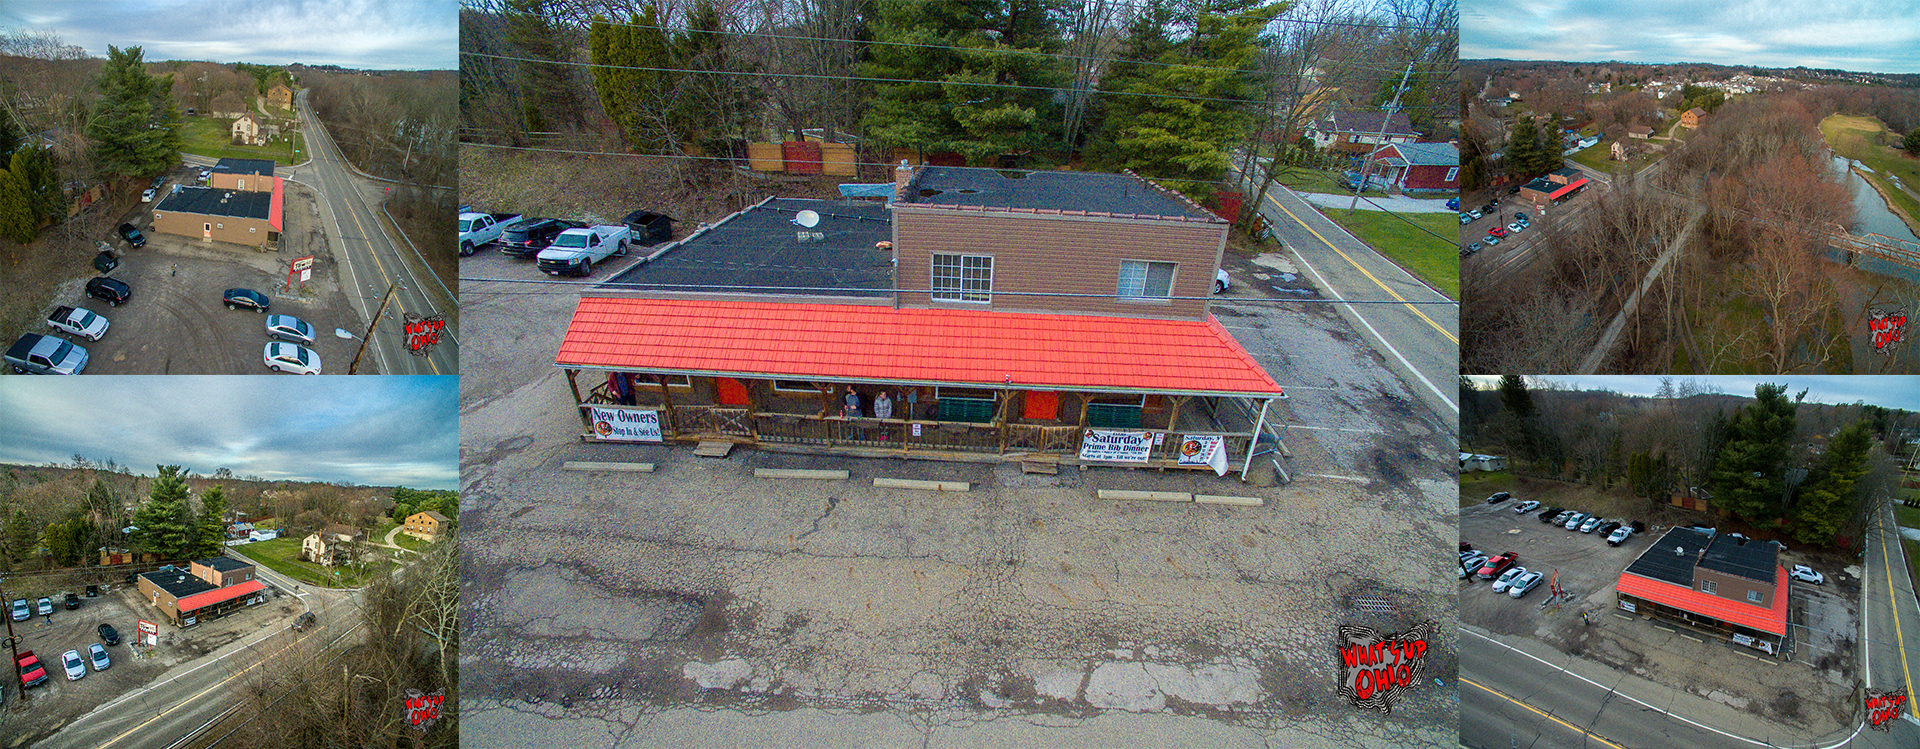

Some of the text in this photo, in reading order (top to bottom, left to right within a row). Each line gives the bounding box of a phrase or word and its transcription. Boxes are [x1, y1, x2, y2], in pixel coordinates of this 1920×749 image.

[593, 408, 657, 424] New Owners
[612, 426, 626, 437] Stop
[638, 427, 650, 436] See
[1091, 433, 1144, 446] Saturday
[1083, 442, 1106, 450] Prime
[1123, 444, 1149, 452] Dinner
